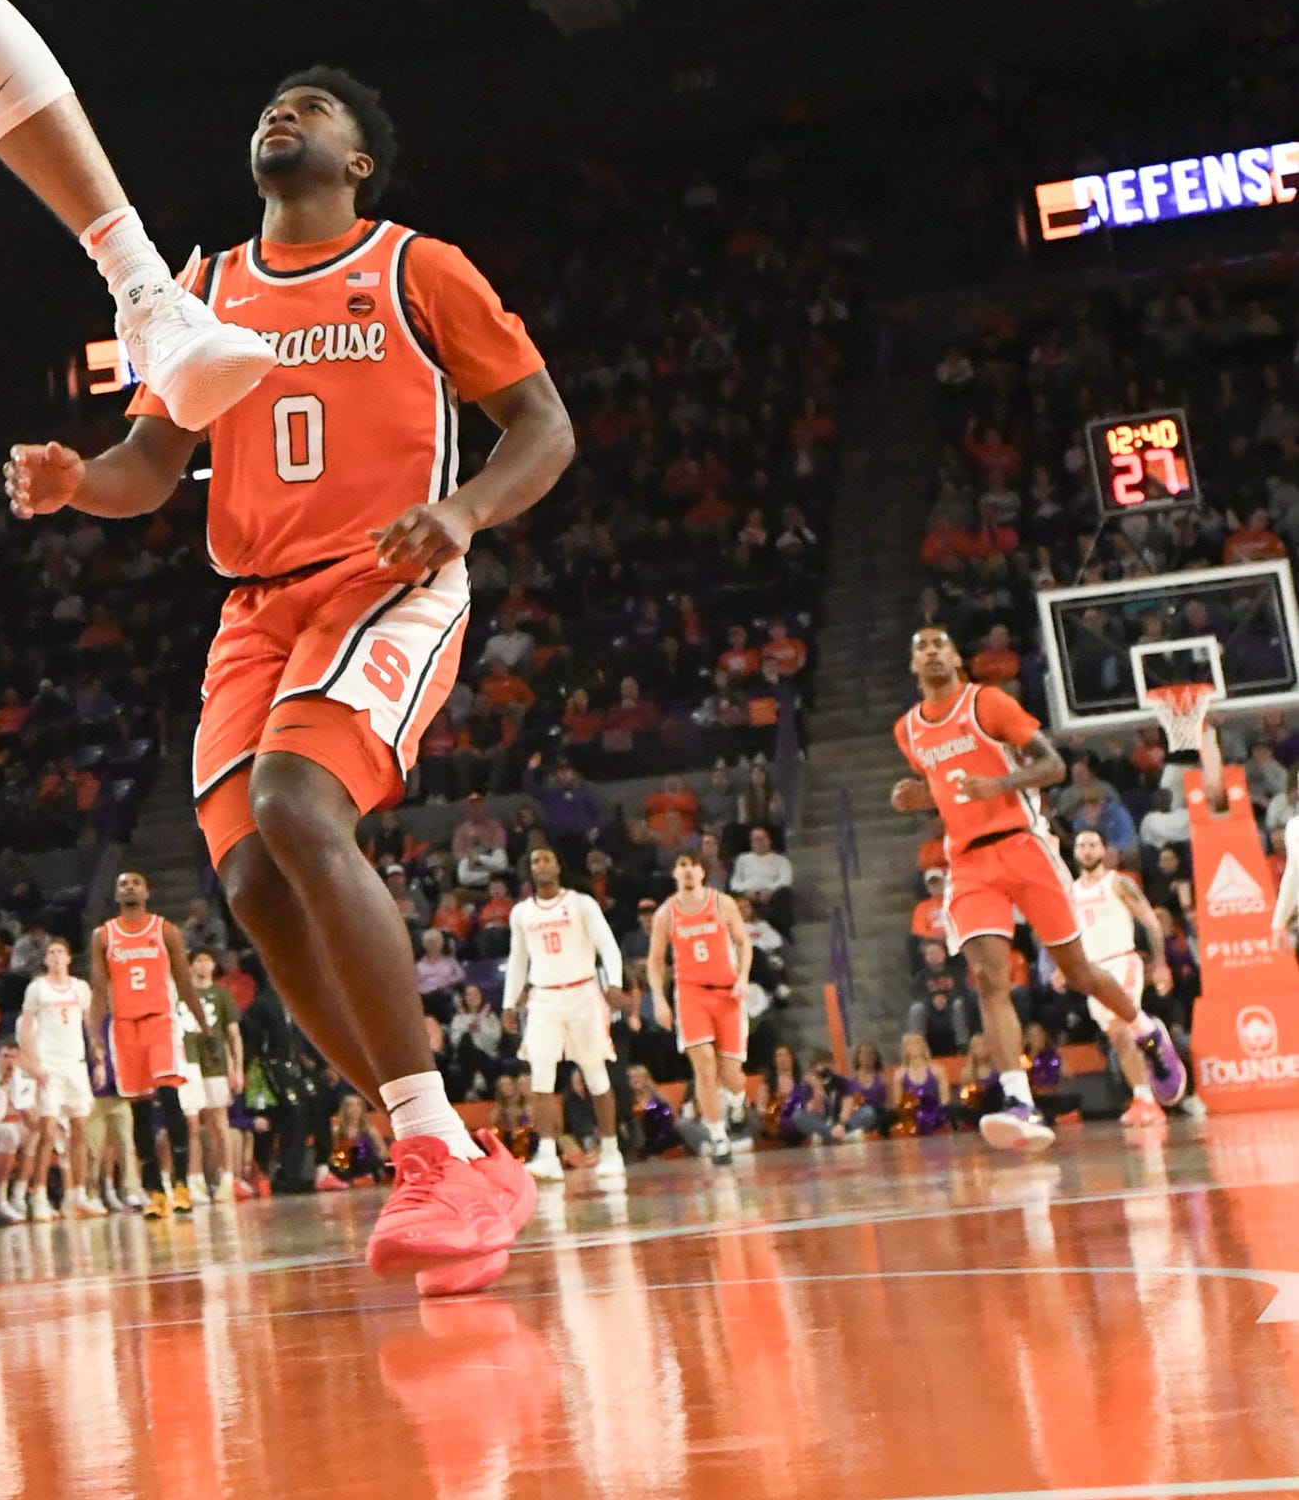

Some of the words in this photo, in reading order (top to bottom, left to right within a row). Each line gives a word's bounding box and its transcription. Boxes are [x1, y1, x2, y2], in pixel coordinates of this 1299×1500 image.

[273, 394, 325, 482] 0
[1106, 418, 1178, 456] 12:40
[1111, 448, 1181, 504] 27
[363, 639, 411, 702] S
[542, 931, 562, 955] 10
[693, 940, 710, 963] 6
[129, 966, 147, 990] 2
